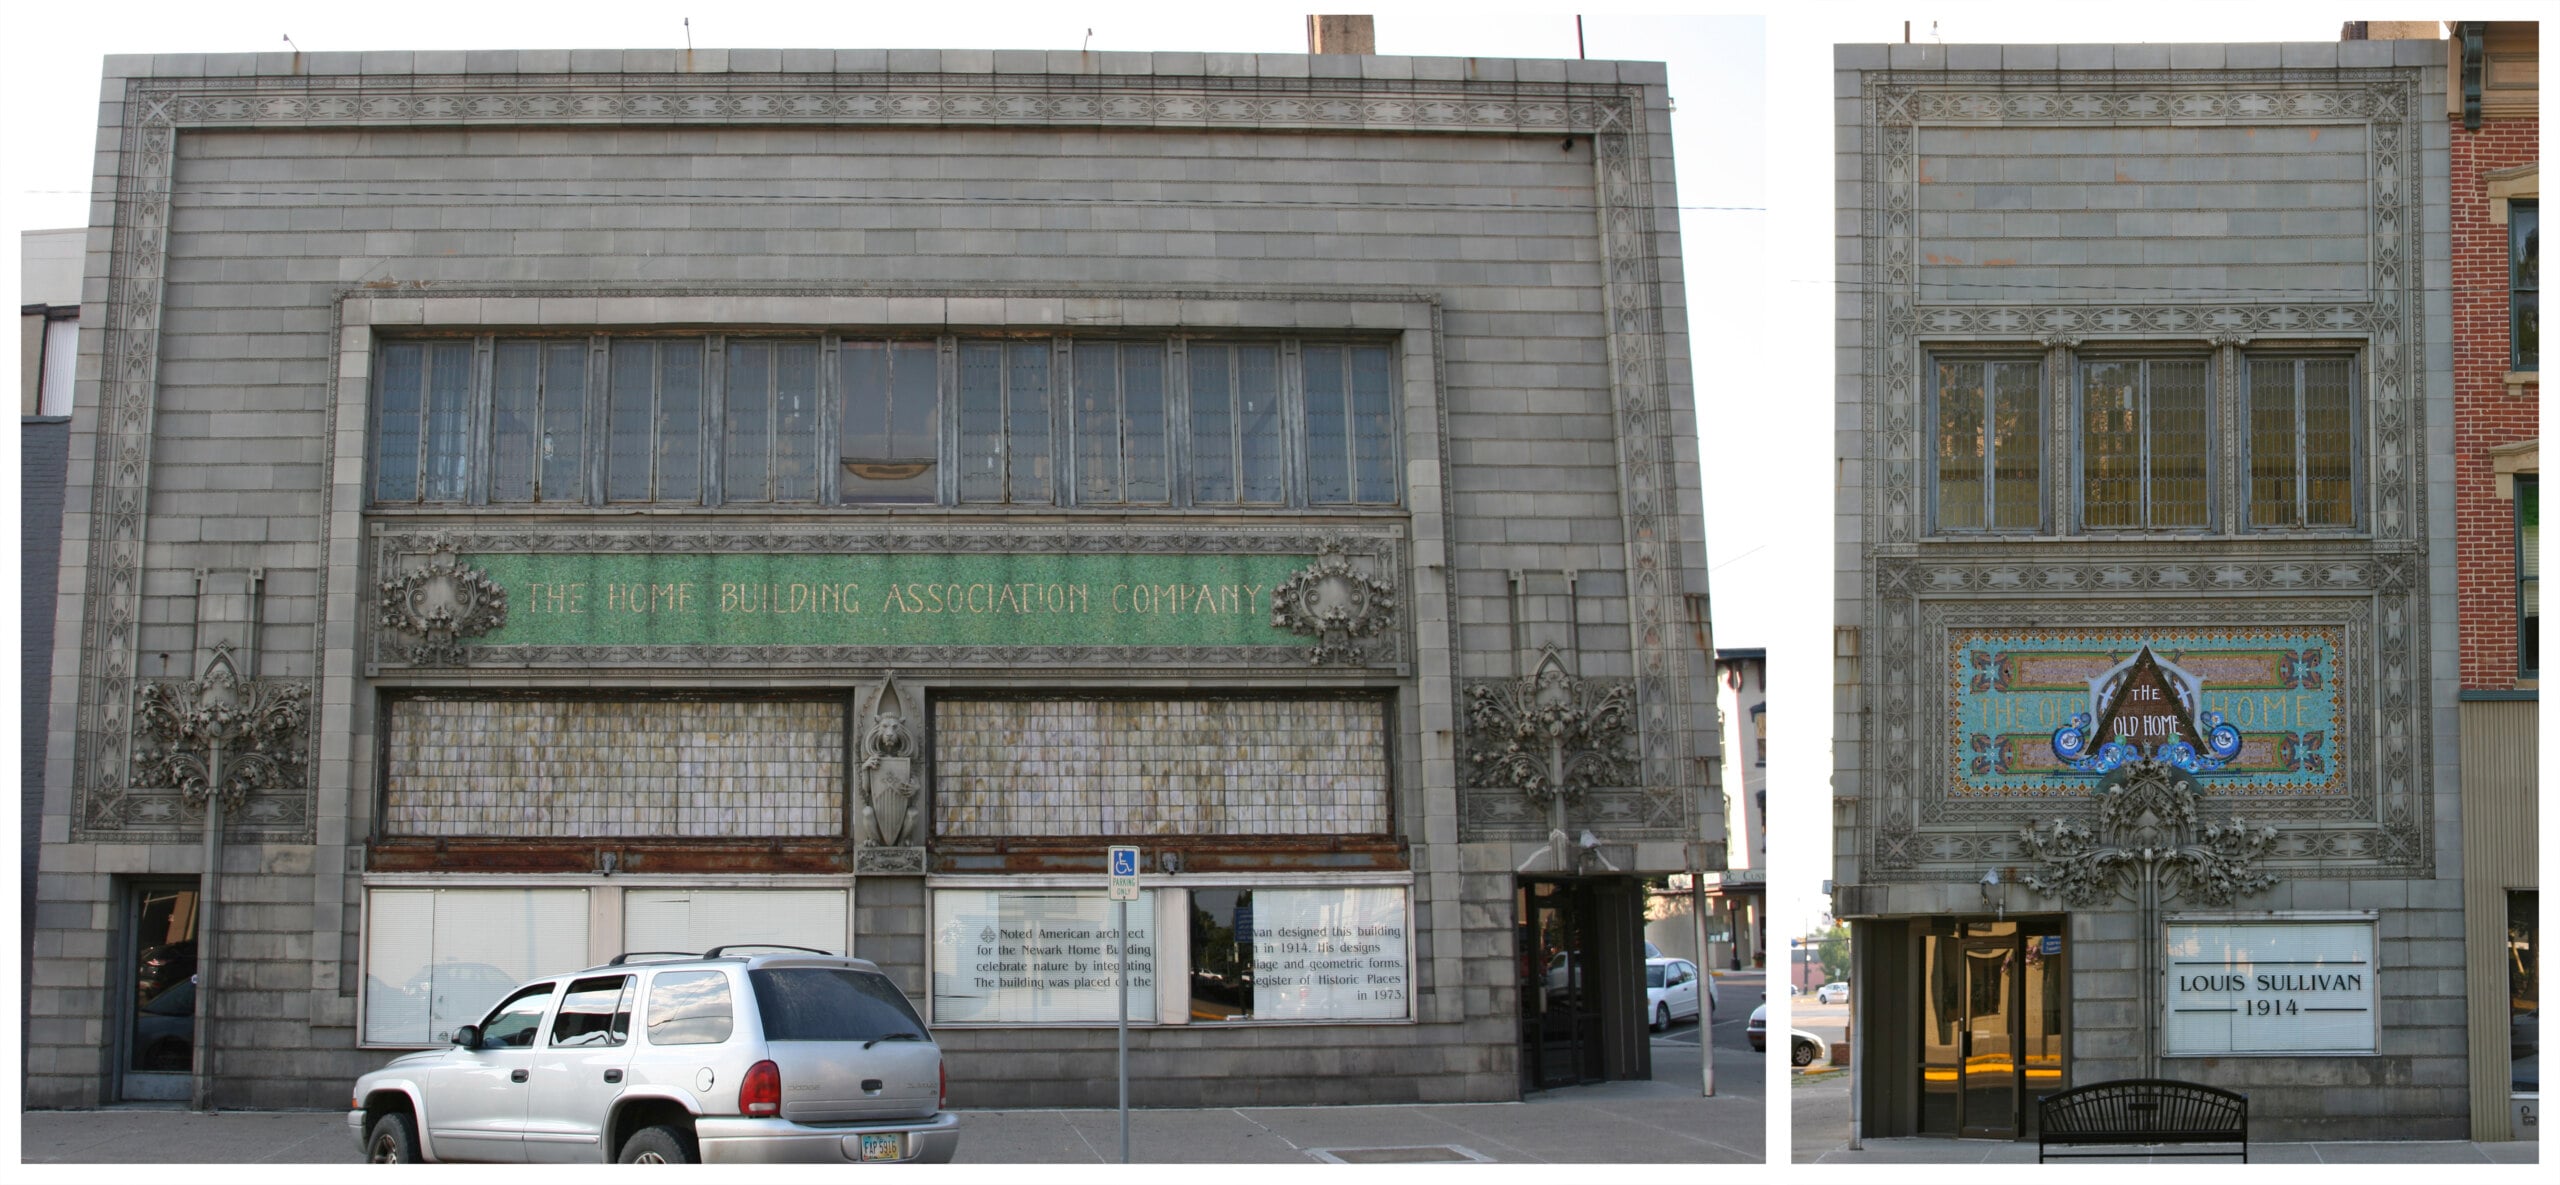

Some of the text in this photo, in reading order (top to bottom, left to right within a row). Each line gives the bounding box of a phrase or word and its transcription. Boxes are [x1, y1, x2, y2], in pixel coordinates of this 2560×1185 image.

[526, 583, 1262, 614] THE HOME BUILDING ASSOCIATION COMPANY
[2131, 684, 2161, 701] THE
[1979, 698, 2025, 729] THE
[2211, 695, 2314, 727] HOME
[2113, 715, 2184, 737] OLD HOME
[1113, 878, 1135, 887] PARKING
[1117, 888, 1131, 896] ONLY
[1000, 928, 1144, 939] Noted American archect
[1278, 927, 1327, 940] designed
[1332, 927, 1352, 937] this
[1356, 927, 1401, 939] building
[977, 944, 1151, 957] for the Newark Home Buding
[1264, 943, 1274, 953] in
[1280, 943, 1312, 953] 1914.
[1317, 943, 1334, 953] His
[1340, 943, 1381, 955] designs
[976, 961, 1152, 973] celebrate nature by integating
[1284, 959, 1304, 969] and
[1309, 959, 1363, 971] geometric
[1369, 959, 1403, 969] forms.
[974, 978, 995, 987] The
[999, 977, 1044, 989] building
[1049, 978, 1070, 987] was
[1074, 977, 1110, 989] placed
[1134, 977, 1152, 987] the
[1299, 975, 1311, 985] of
[1318, 975, 1359, 985] Historic
[1367, 974, 1401, 985] Places
[2180, 974, 2361, 992] LOUIS SULLIVAN
[1357, 990, 1405, 1001] in 1973.
[2246, 999, 2299, 1016] 1914
[865, 1140, 897, 1154] FAP 5916
